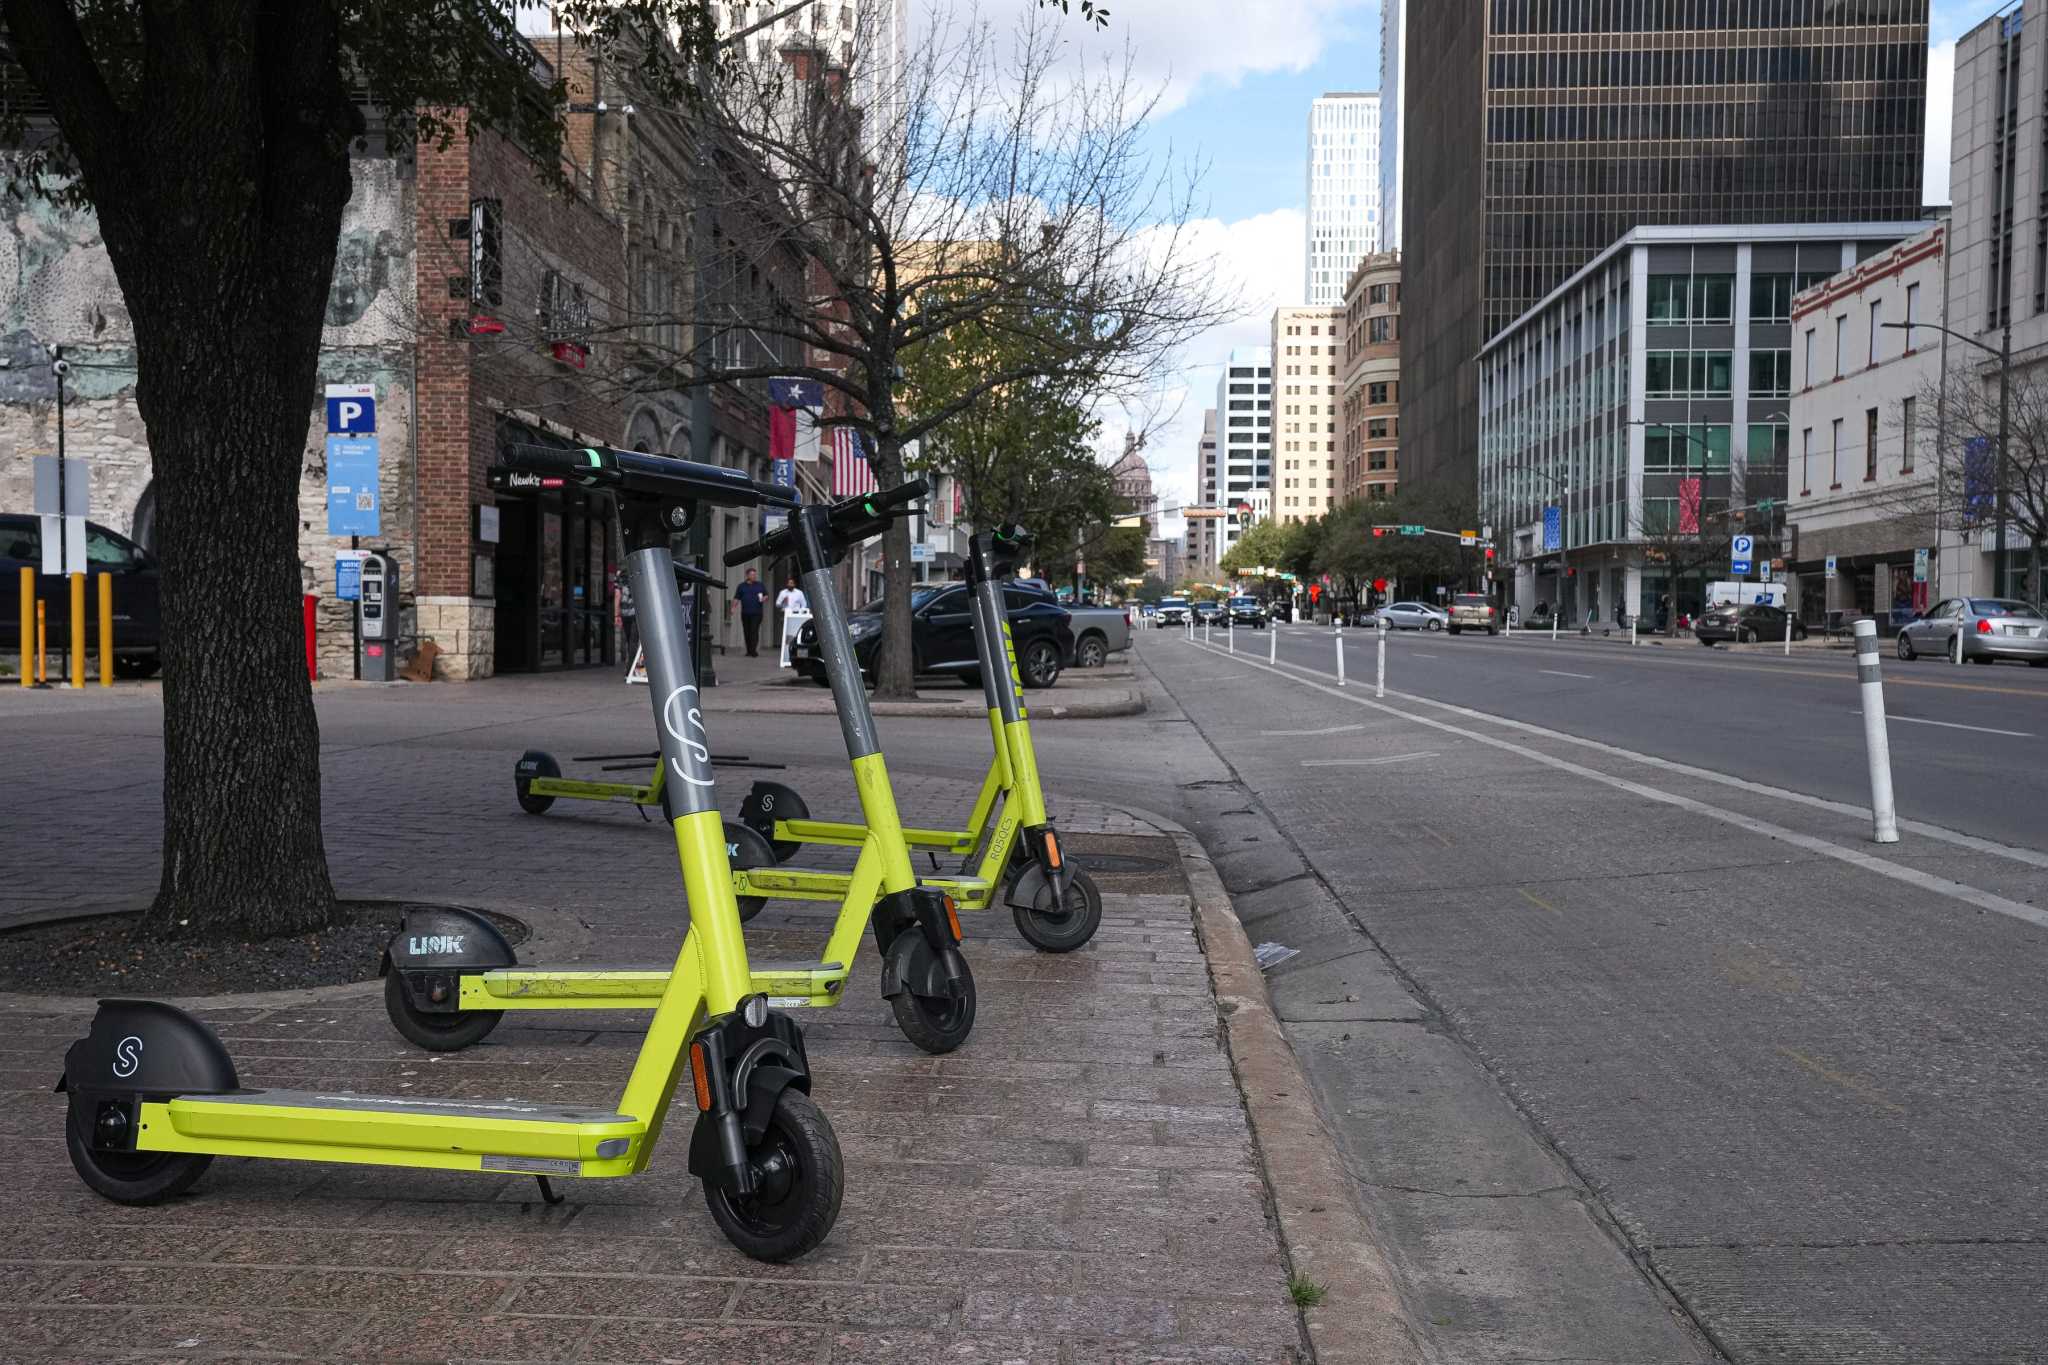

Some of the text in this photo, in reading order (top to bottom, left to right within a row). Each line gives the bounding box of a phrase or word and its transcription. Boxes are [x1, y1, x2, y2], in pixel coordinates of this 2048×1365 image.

[339, 402, 362, 428] P
[509, 472, 540, 487] Newk's
[1738, 539, 1748, 551] P
[409, 935, 465, 955] LINK
